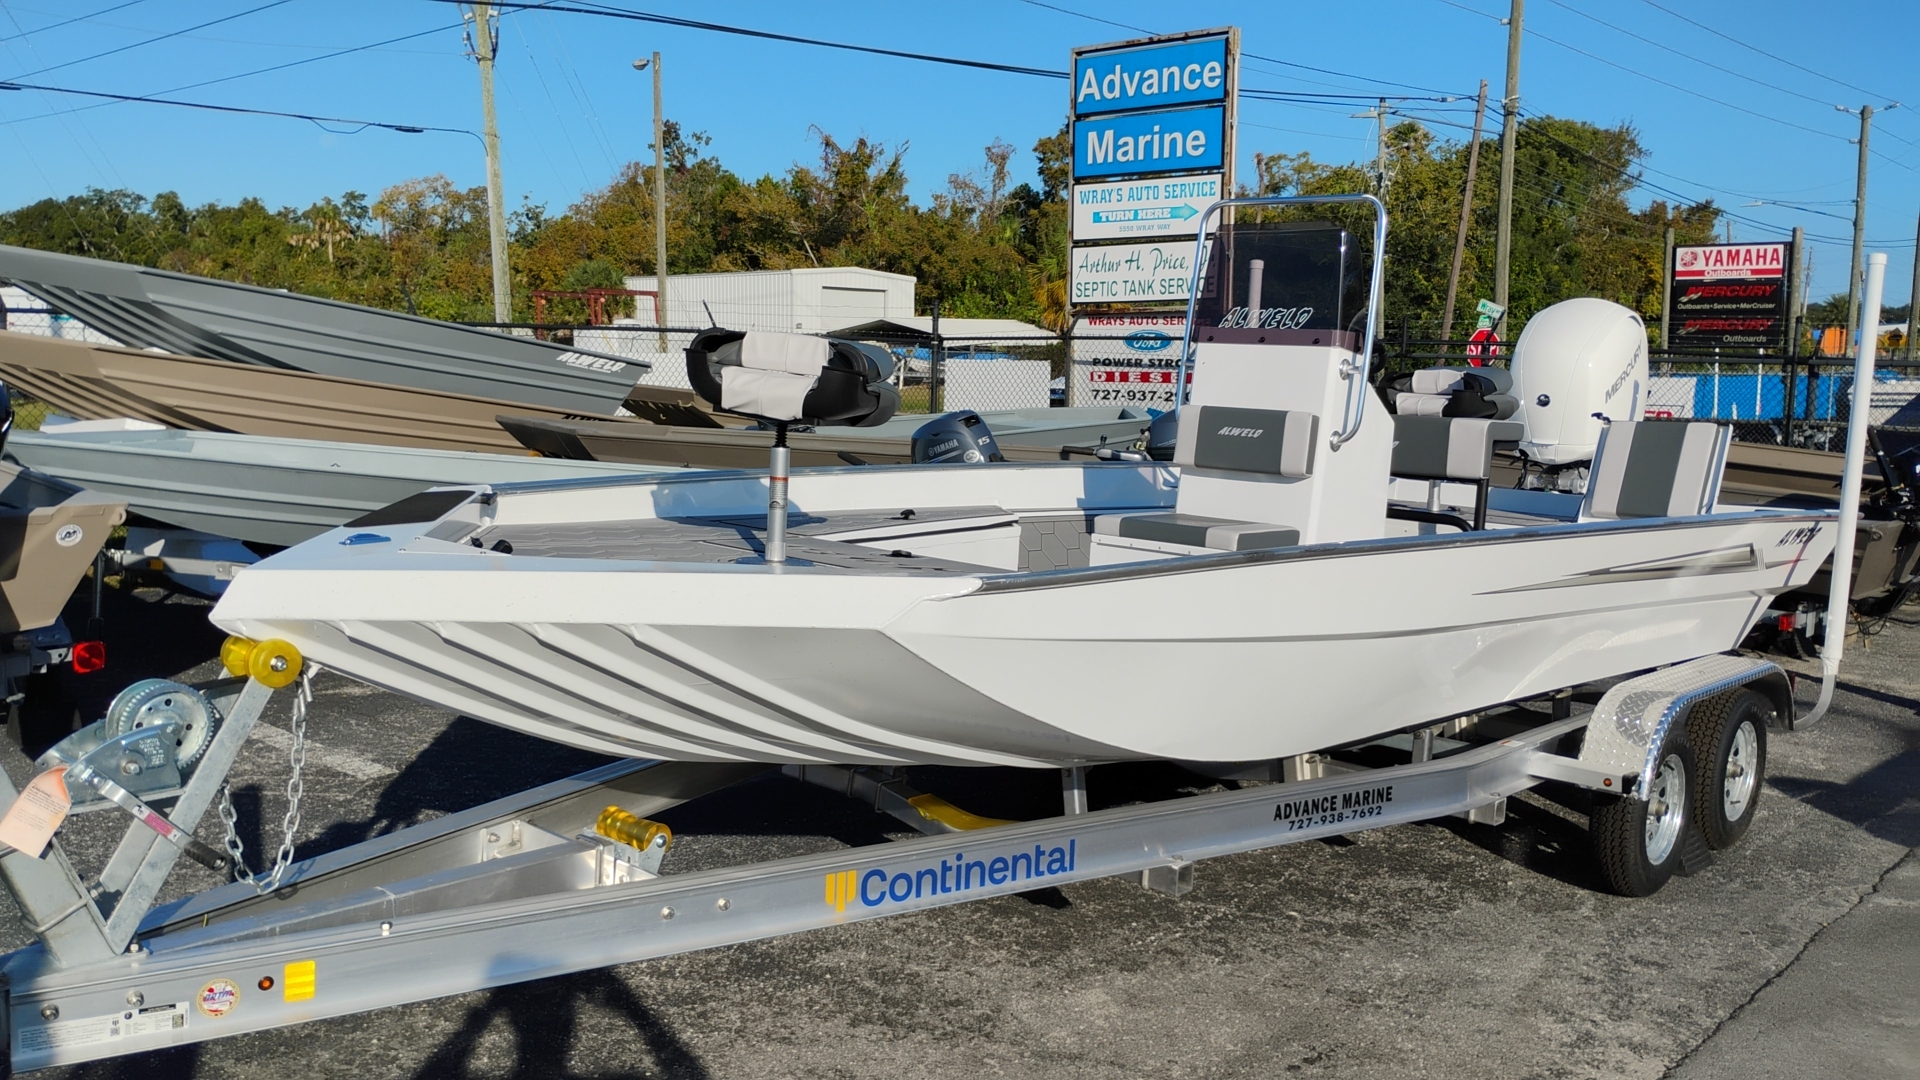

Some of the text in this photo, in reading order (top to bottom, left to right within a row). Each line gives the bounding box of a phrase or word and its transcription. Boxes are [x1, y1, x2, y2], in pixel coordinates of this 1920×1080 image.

[1077, 60, 1222, 103] Advance
[1087, 125, 1206, 165] Marine
[1079, 181, 1216, 205] WRAY'S AUTO SERVICE
[1099, 207, 1171, 222] TURN HERE
[1076, 252, 1121, 279] Arthur
[1125, 250, 1144, 272] H.
[1150, 248, 1189, 277] Price,
[1702, 248, 1780, 267] YAMAHA
[1704, 269, 1752, 277] Outboards
[1075, 275, 1215, 298] SEPTIC TANK SERVCE
[1685, 285, 1776, 297] MERCURY
[1088, 316, 1125, 326] WRAYS
[1128, 316, 1159, 326] AUTO
[1218, 306, 1313, 330] ALWELD
[1684, 319, 1775, 331] MERCURY
[1133, 332, 1162, 349] Ford
[1723, 335, 1767, 343] Outboards
[1469, 344, 1497, 356] STP
[556, 351, 627, 372] ALWELD
[1092, 358, 1143, 368] POWER
[1092, 371, 1180, 383] DIESE
[1605, 339, 1642, 404] MERCURY
[933, 438, 959, 454] YAMAHA
[977, 435, 990, 446] 15
[1273, 786, 1393, 821] ADVANCE MARINE
[1288, 805, 1382, 831] 727-938-7692
[860, 839, 1076, 907] Continental
